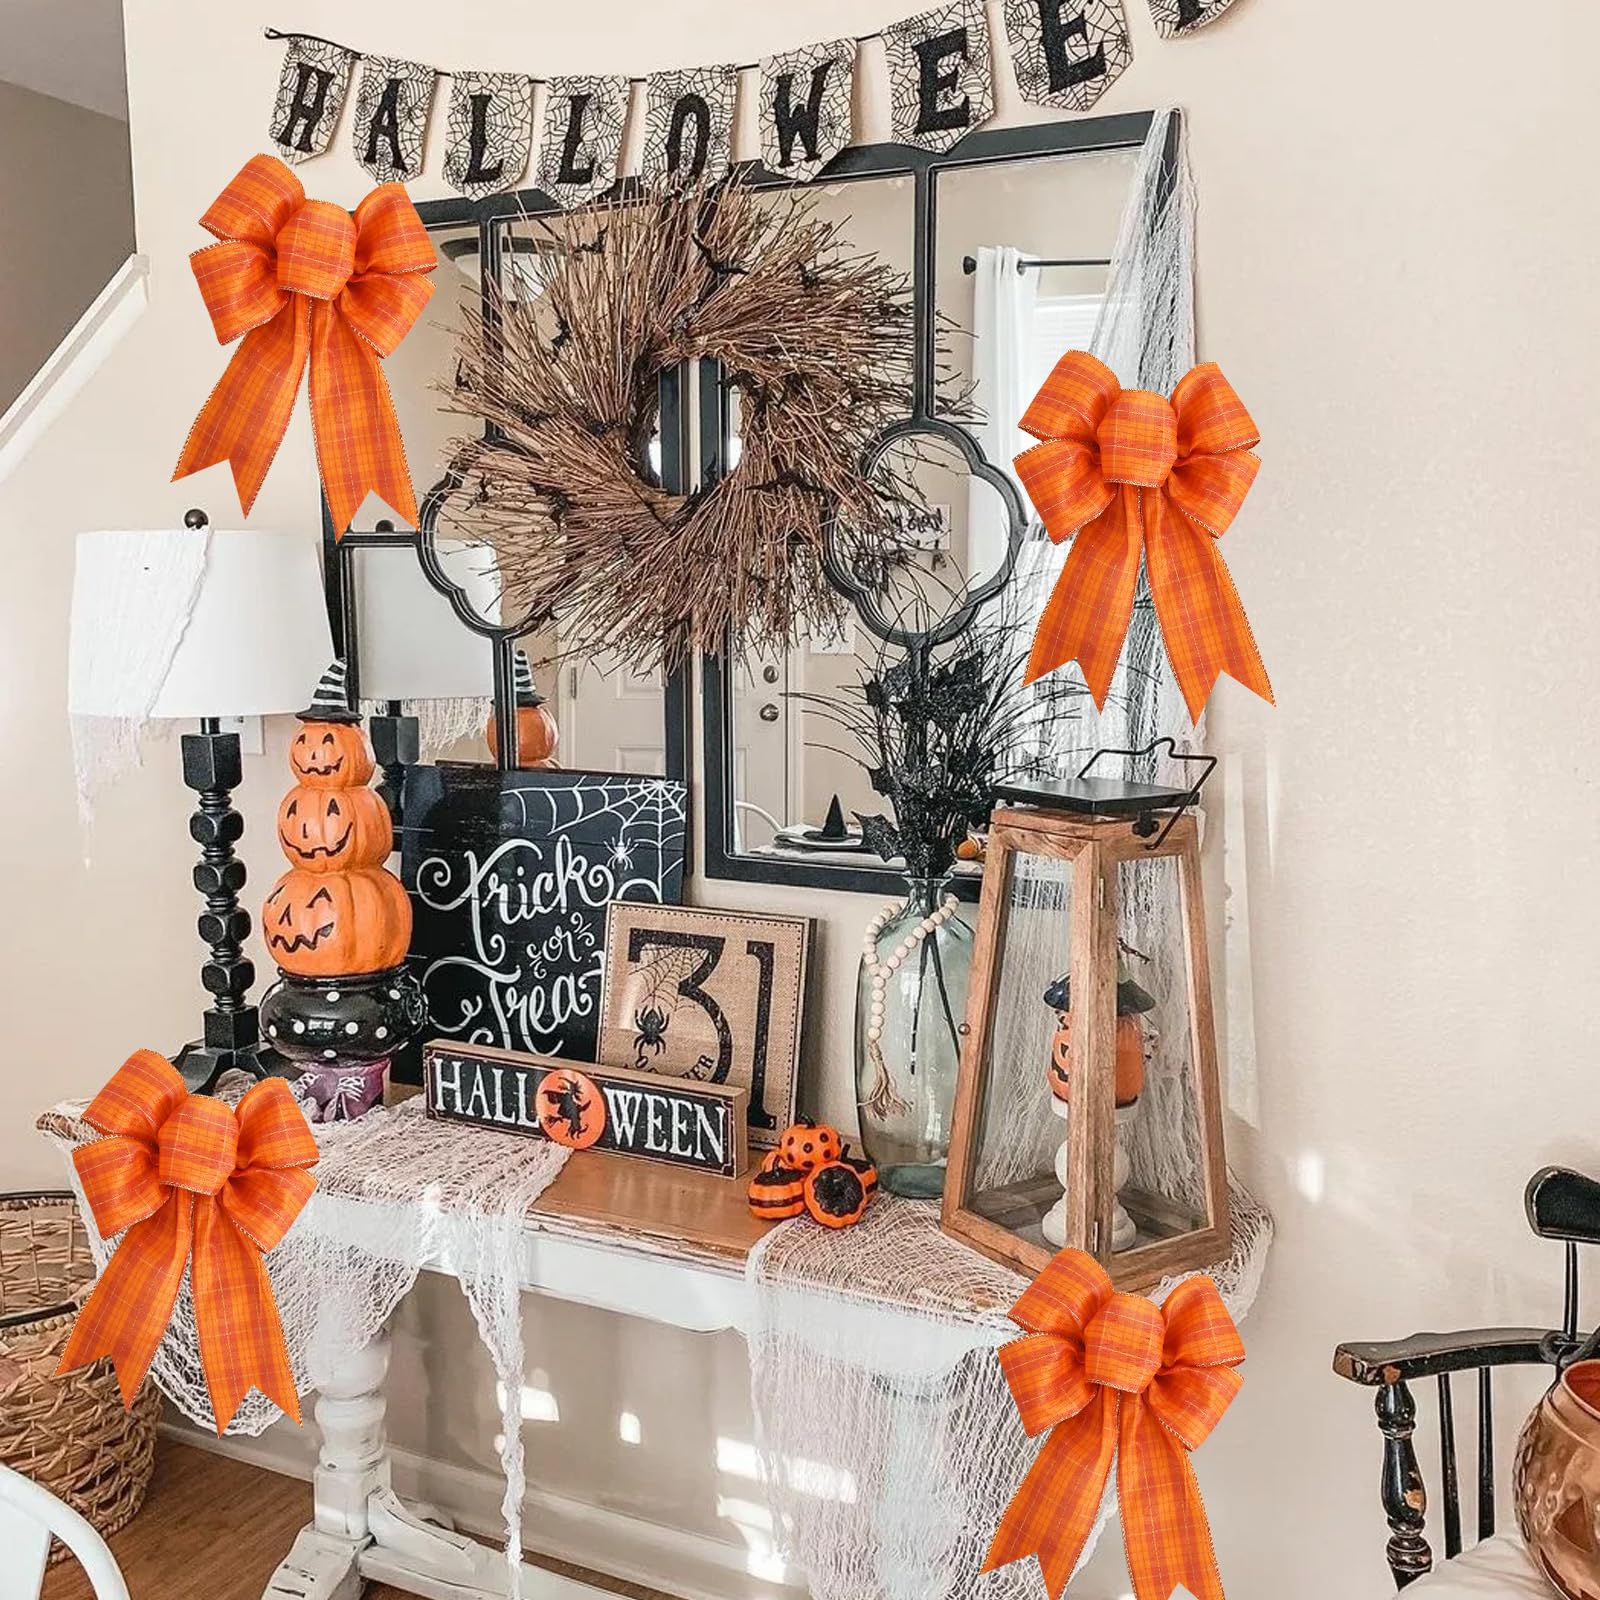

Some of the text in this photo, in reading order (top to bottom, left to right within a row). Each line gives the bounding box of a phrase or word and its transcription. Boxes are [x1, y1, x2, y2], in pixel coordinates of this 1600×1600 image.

[417, 834, 614, 966] Trick
[422, 950, 605, 1056] Trea
[628, 927, 777, 1131] 31
